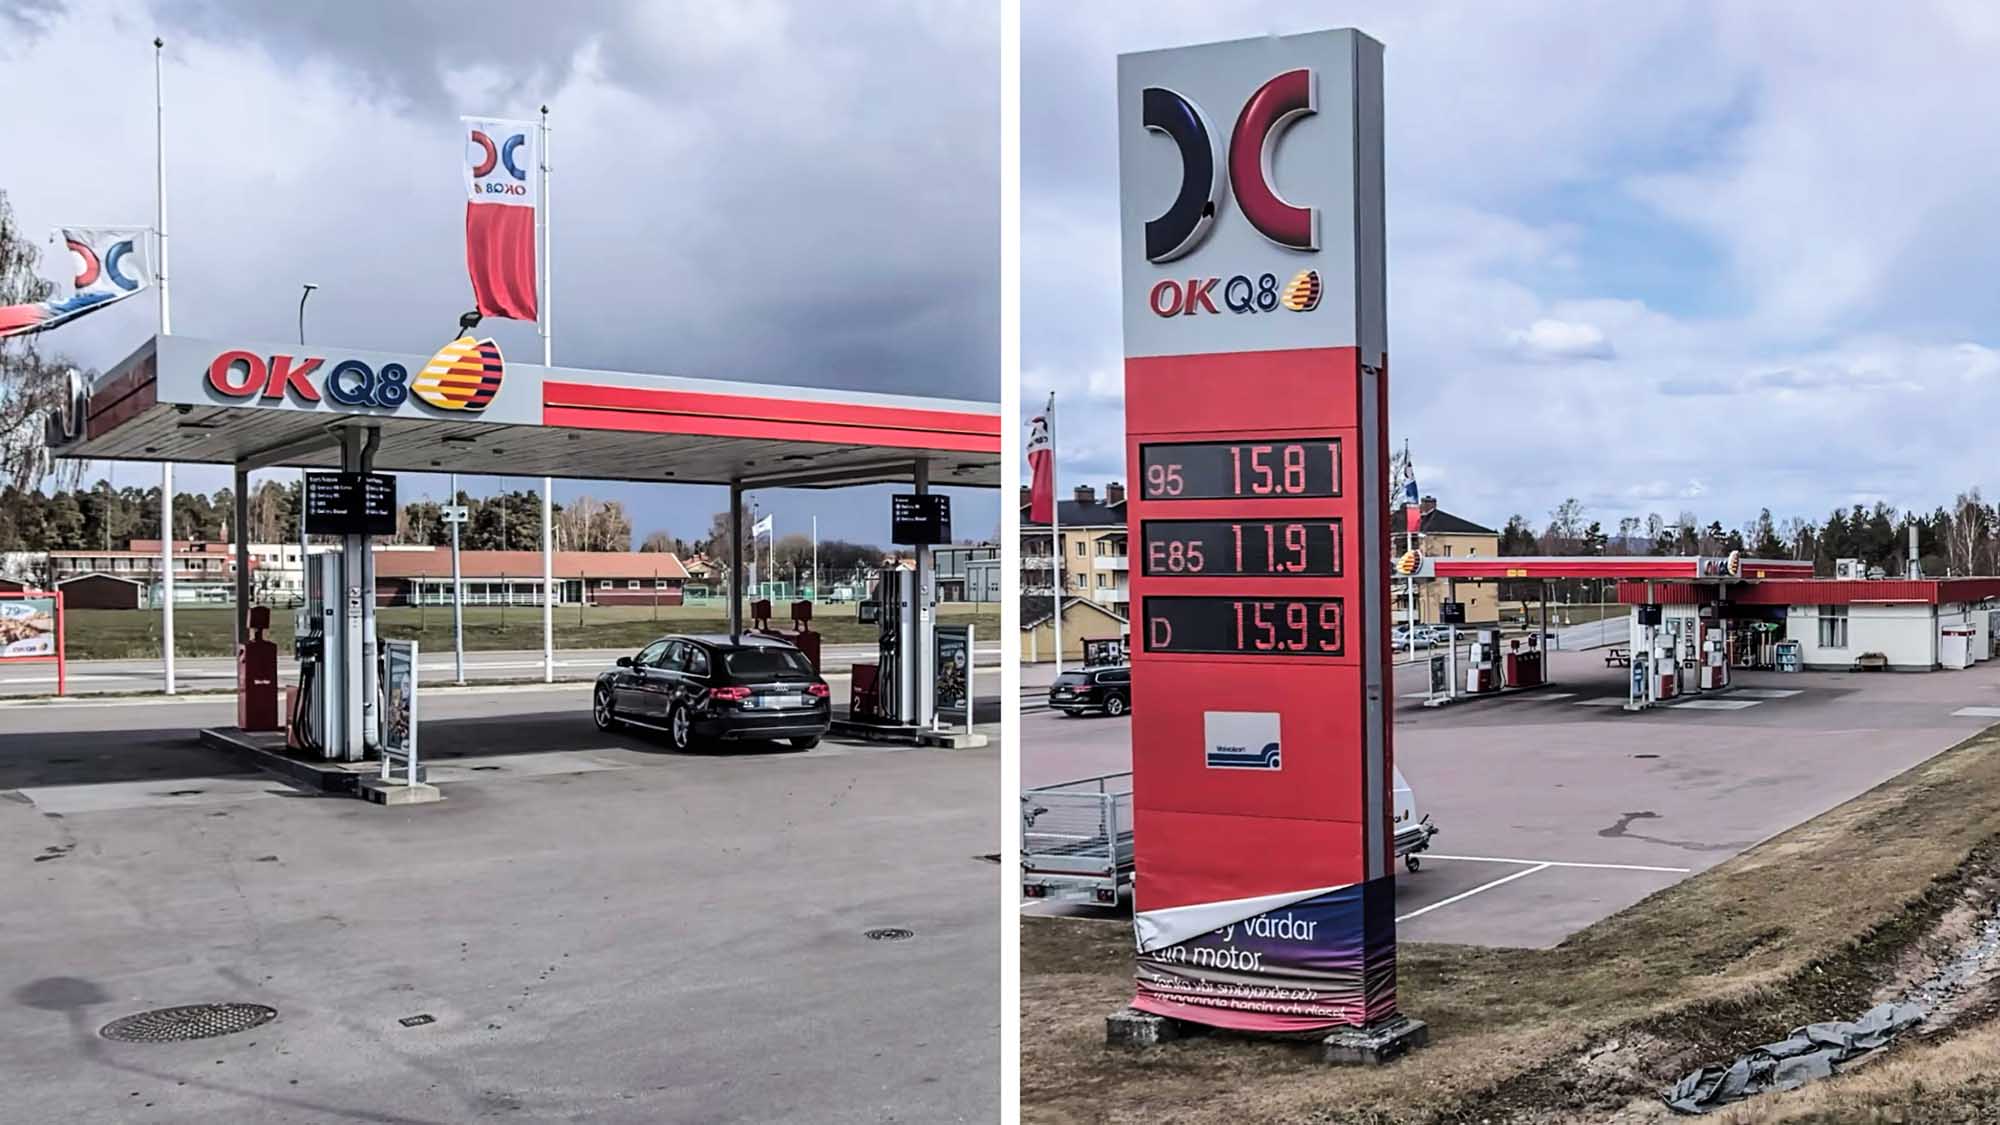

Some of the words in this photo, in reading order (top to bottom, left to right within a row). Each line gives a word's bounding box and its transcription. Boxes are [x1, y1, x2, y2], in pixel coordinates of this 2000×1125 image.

[1148, 464, 1184, 496] 95
[1231, 443, 1339, 494] 15.81
[1149, 541, 1204, 572] E85
[1232, 523, 1340, 572] 11.91
[1151, 617, 1172, 648] D
[1233, 602, 1341, 650] 15.99
[853, 696, 861, 712] 2
[1244, 912, 1317, 941] vårdar
[1192, 945, 1265, 972] motor.
